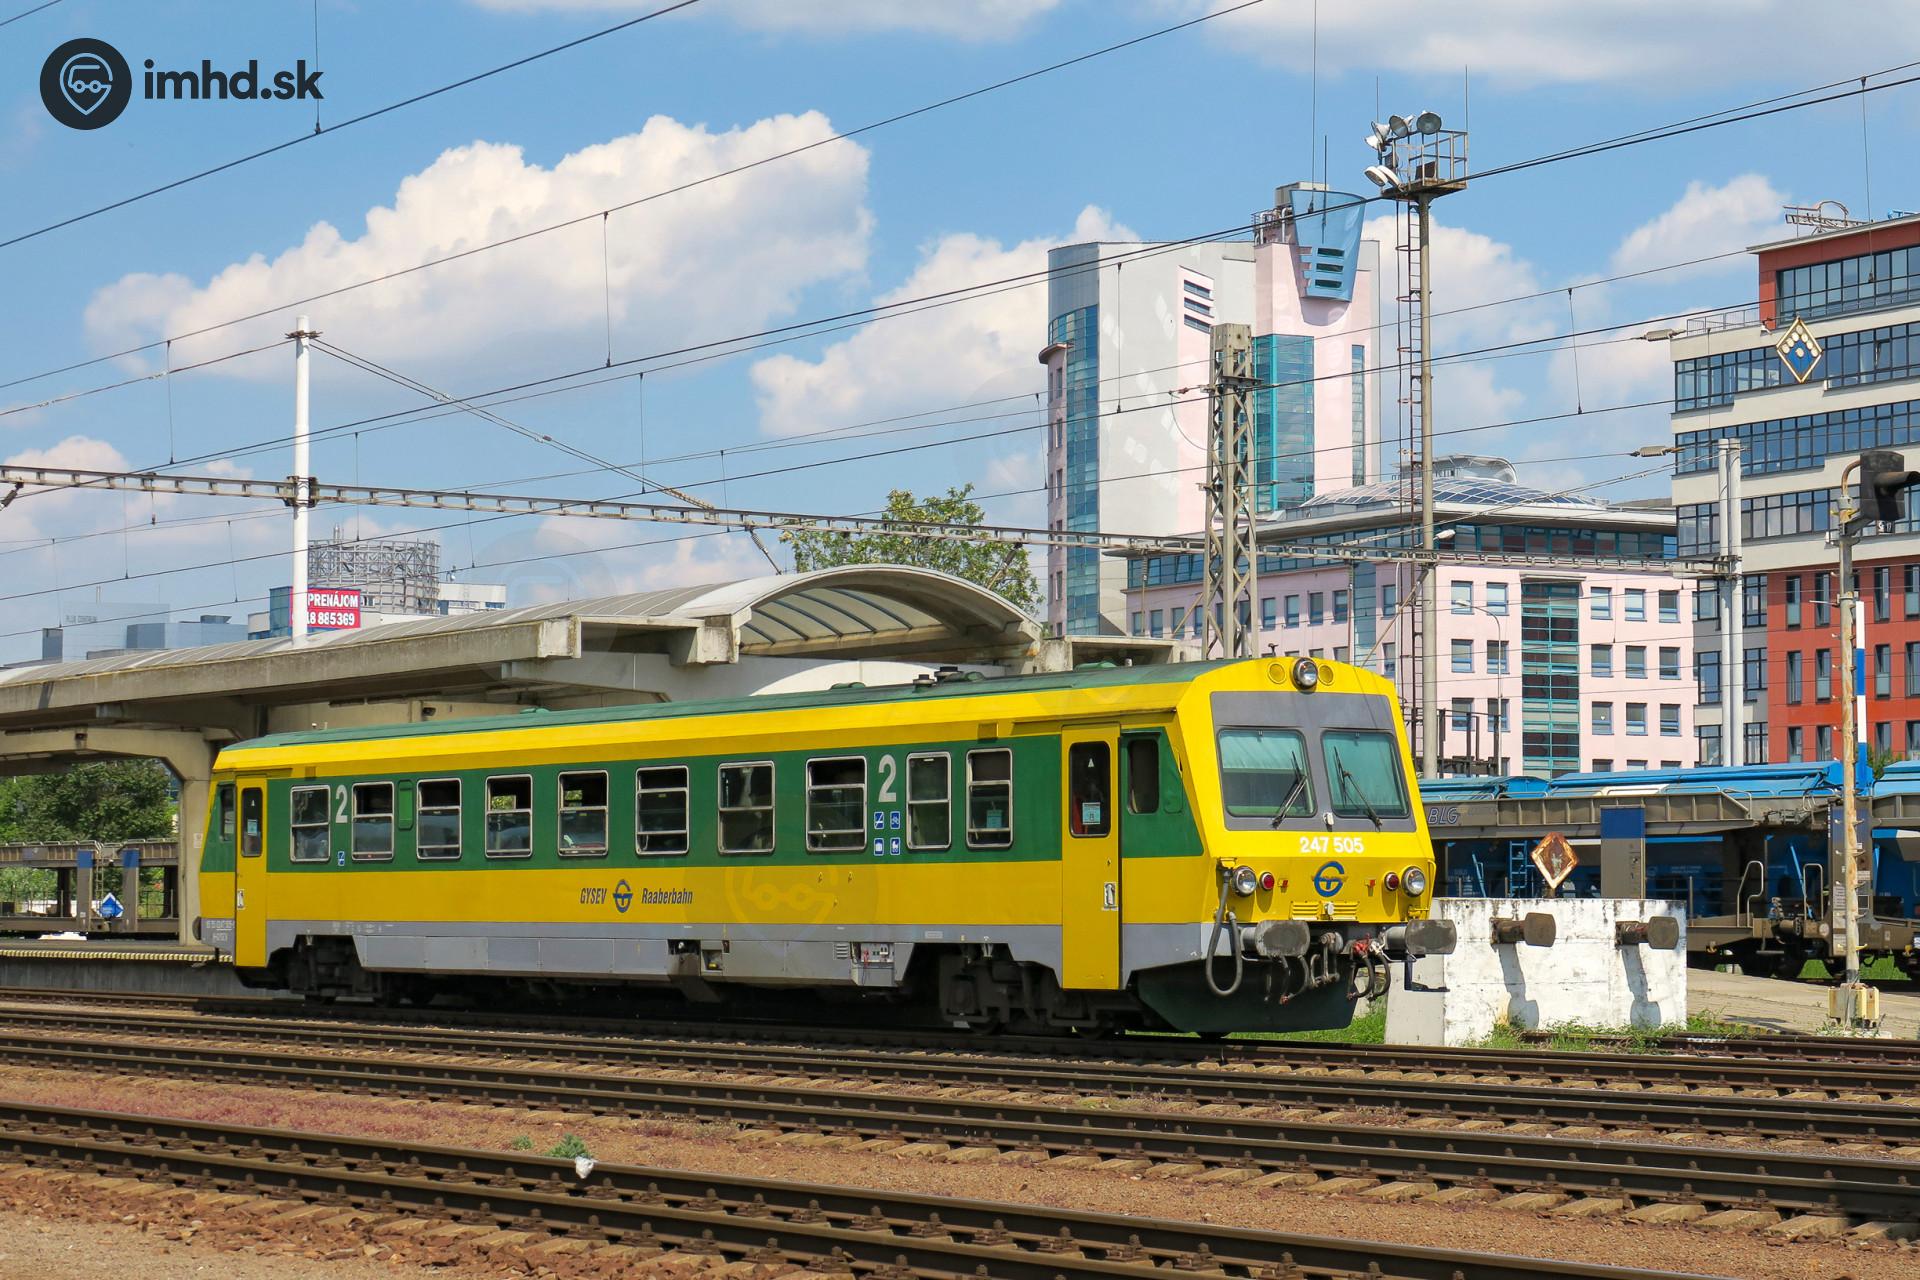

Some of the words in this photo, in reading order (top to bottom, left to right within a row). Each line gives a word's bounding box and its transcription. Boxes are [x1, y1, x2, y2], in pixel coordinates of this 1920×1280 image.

[307, 591, 359, 608] PRENÁJOM
[878, 754, 897, 803] 2
[335, 784, 348, 824] 2
[1427, 806, 1459, 825] BLG
[1299, 836, 1329, 854] 247
[1333, 836, 1365, 854] 505
[580, 887, 608, 905] GYSEV
[641, 887, 694, 905] Raaberbahn
